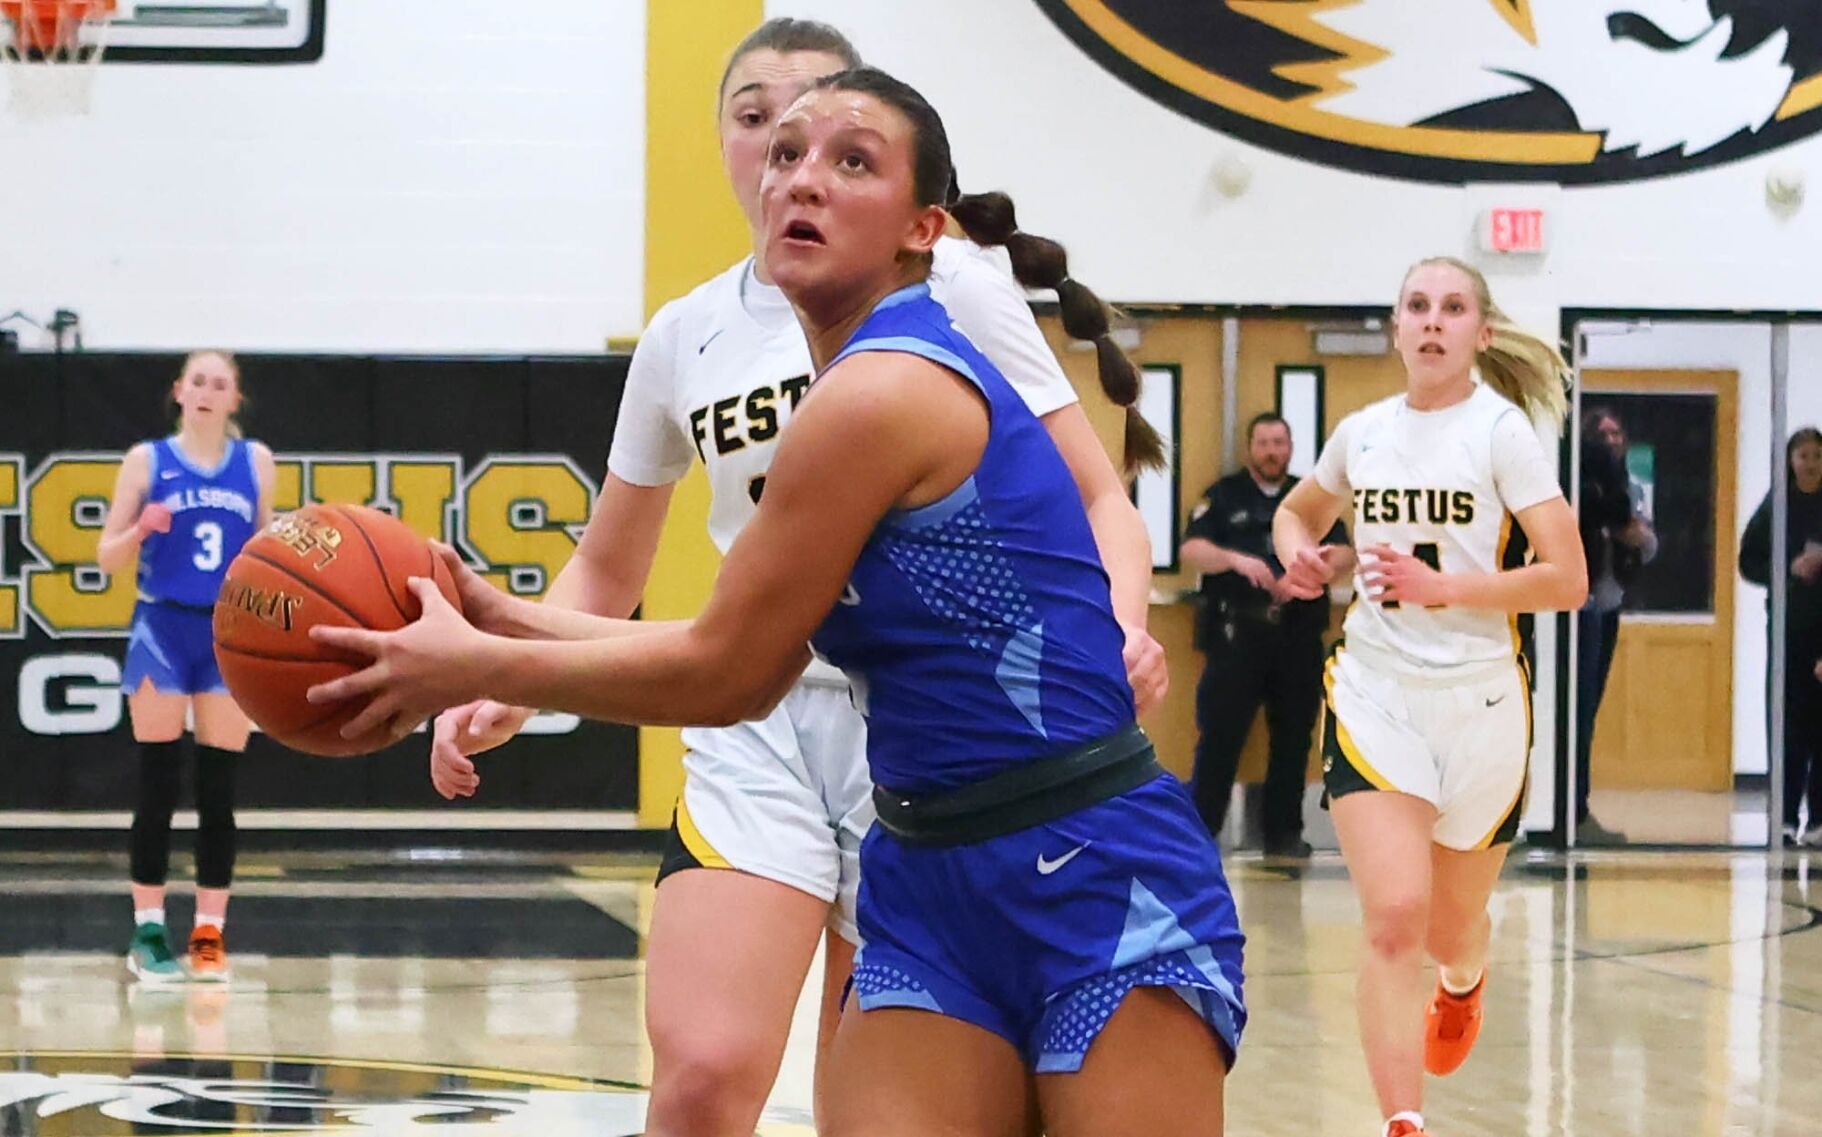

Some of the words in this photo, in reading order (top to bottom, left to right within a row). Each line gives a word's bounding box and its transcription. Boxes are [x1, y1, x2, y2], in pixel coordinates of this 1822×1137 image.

[1492, 208, 1543, 250] EXIT
[690, 373, 811, 465] FEST
[193, 522, 222, 572] 3
